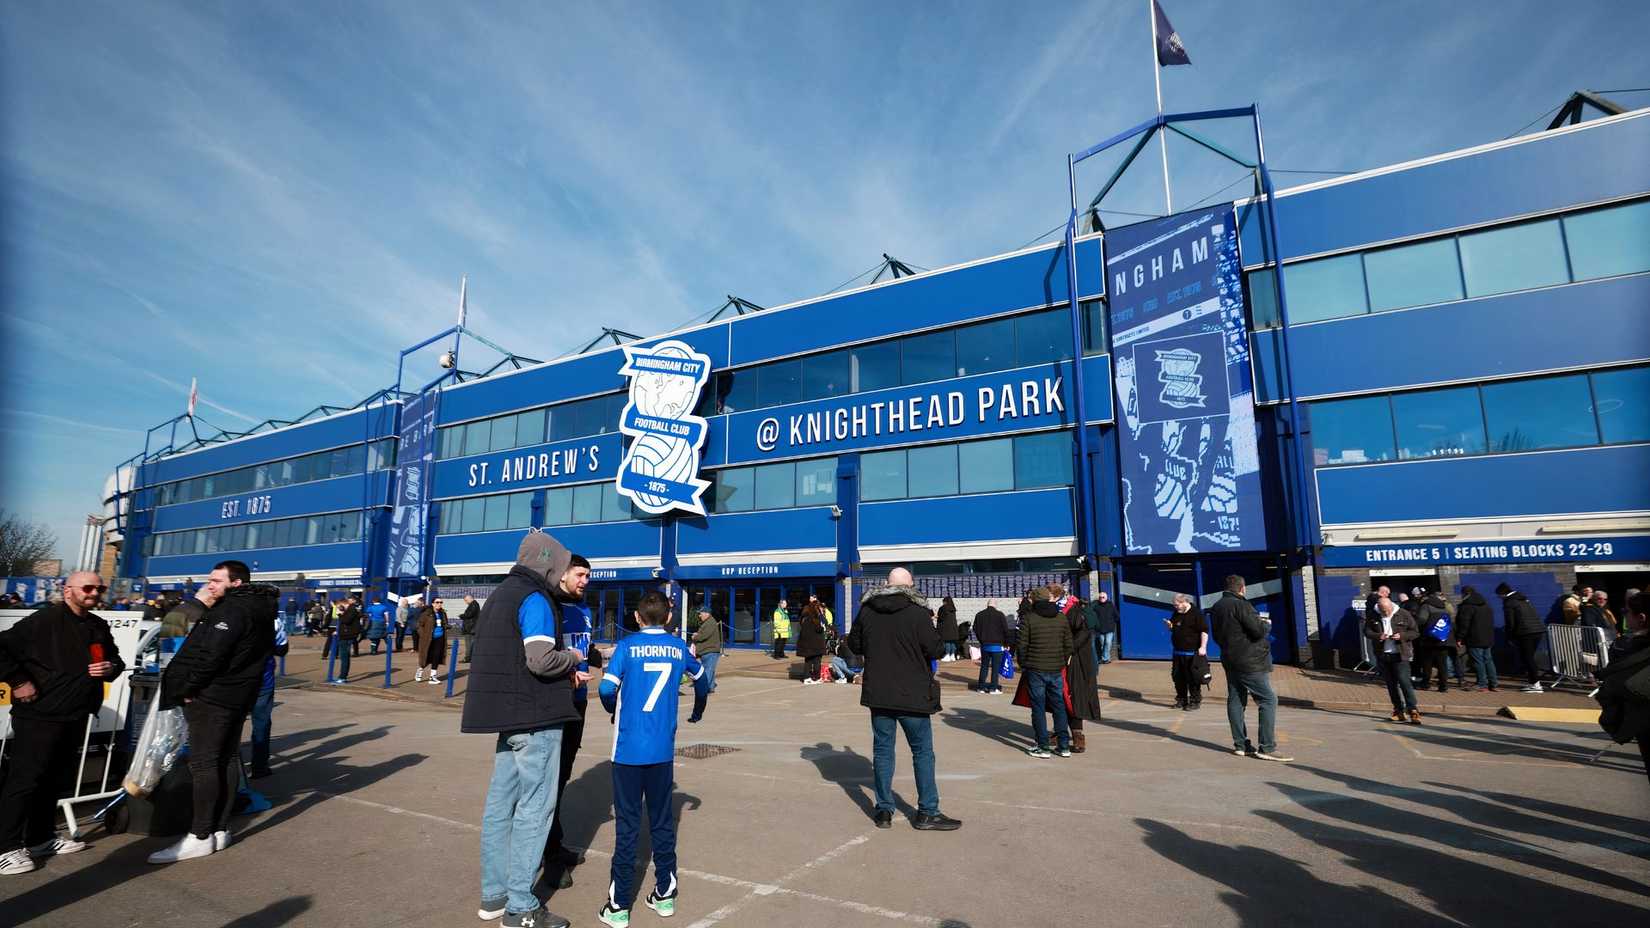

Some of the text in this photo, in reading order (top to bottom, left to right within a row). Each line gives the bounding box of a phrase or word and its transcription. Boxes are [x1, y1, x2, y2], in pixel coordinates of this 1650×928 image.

[1115, 236, 1208, 296] NGHAM
[635, 357, 701, 374] BIRMINGHAM CITY
[756, 376, 1065, 451] @ KNIGHTHEAD PARK
[634, 417, 690, 435] FOOTBALL CLUB
[468, 445, 599, 487] ST. ANDREW'S
[246, 495, 272, 515] 1875
[1366, 548, 1428, 561] ENTRANCE
[1431, 547, 1440, 560] 5
[1454, 545, 1508, 559] SEATING
[1512, 544, 1564, 557] BLOCKS
[1568, 542, 1613, 556] 22-29
[589, 570, 617, 578] ECEPTION
[738, 566, 778, 575] RECEPTION
[630, 645, 682, 660] THORNTON
[642, 662, 672, 712] 7
